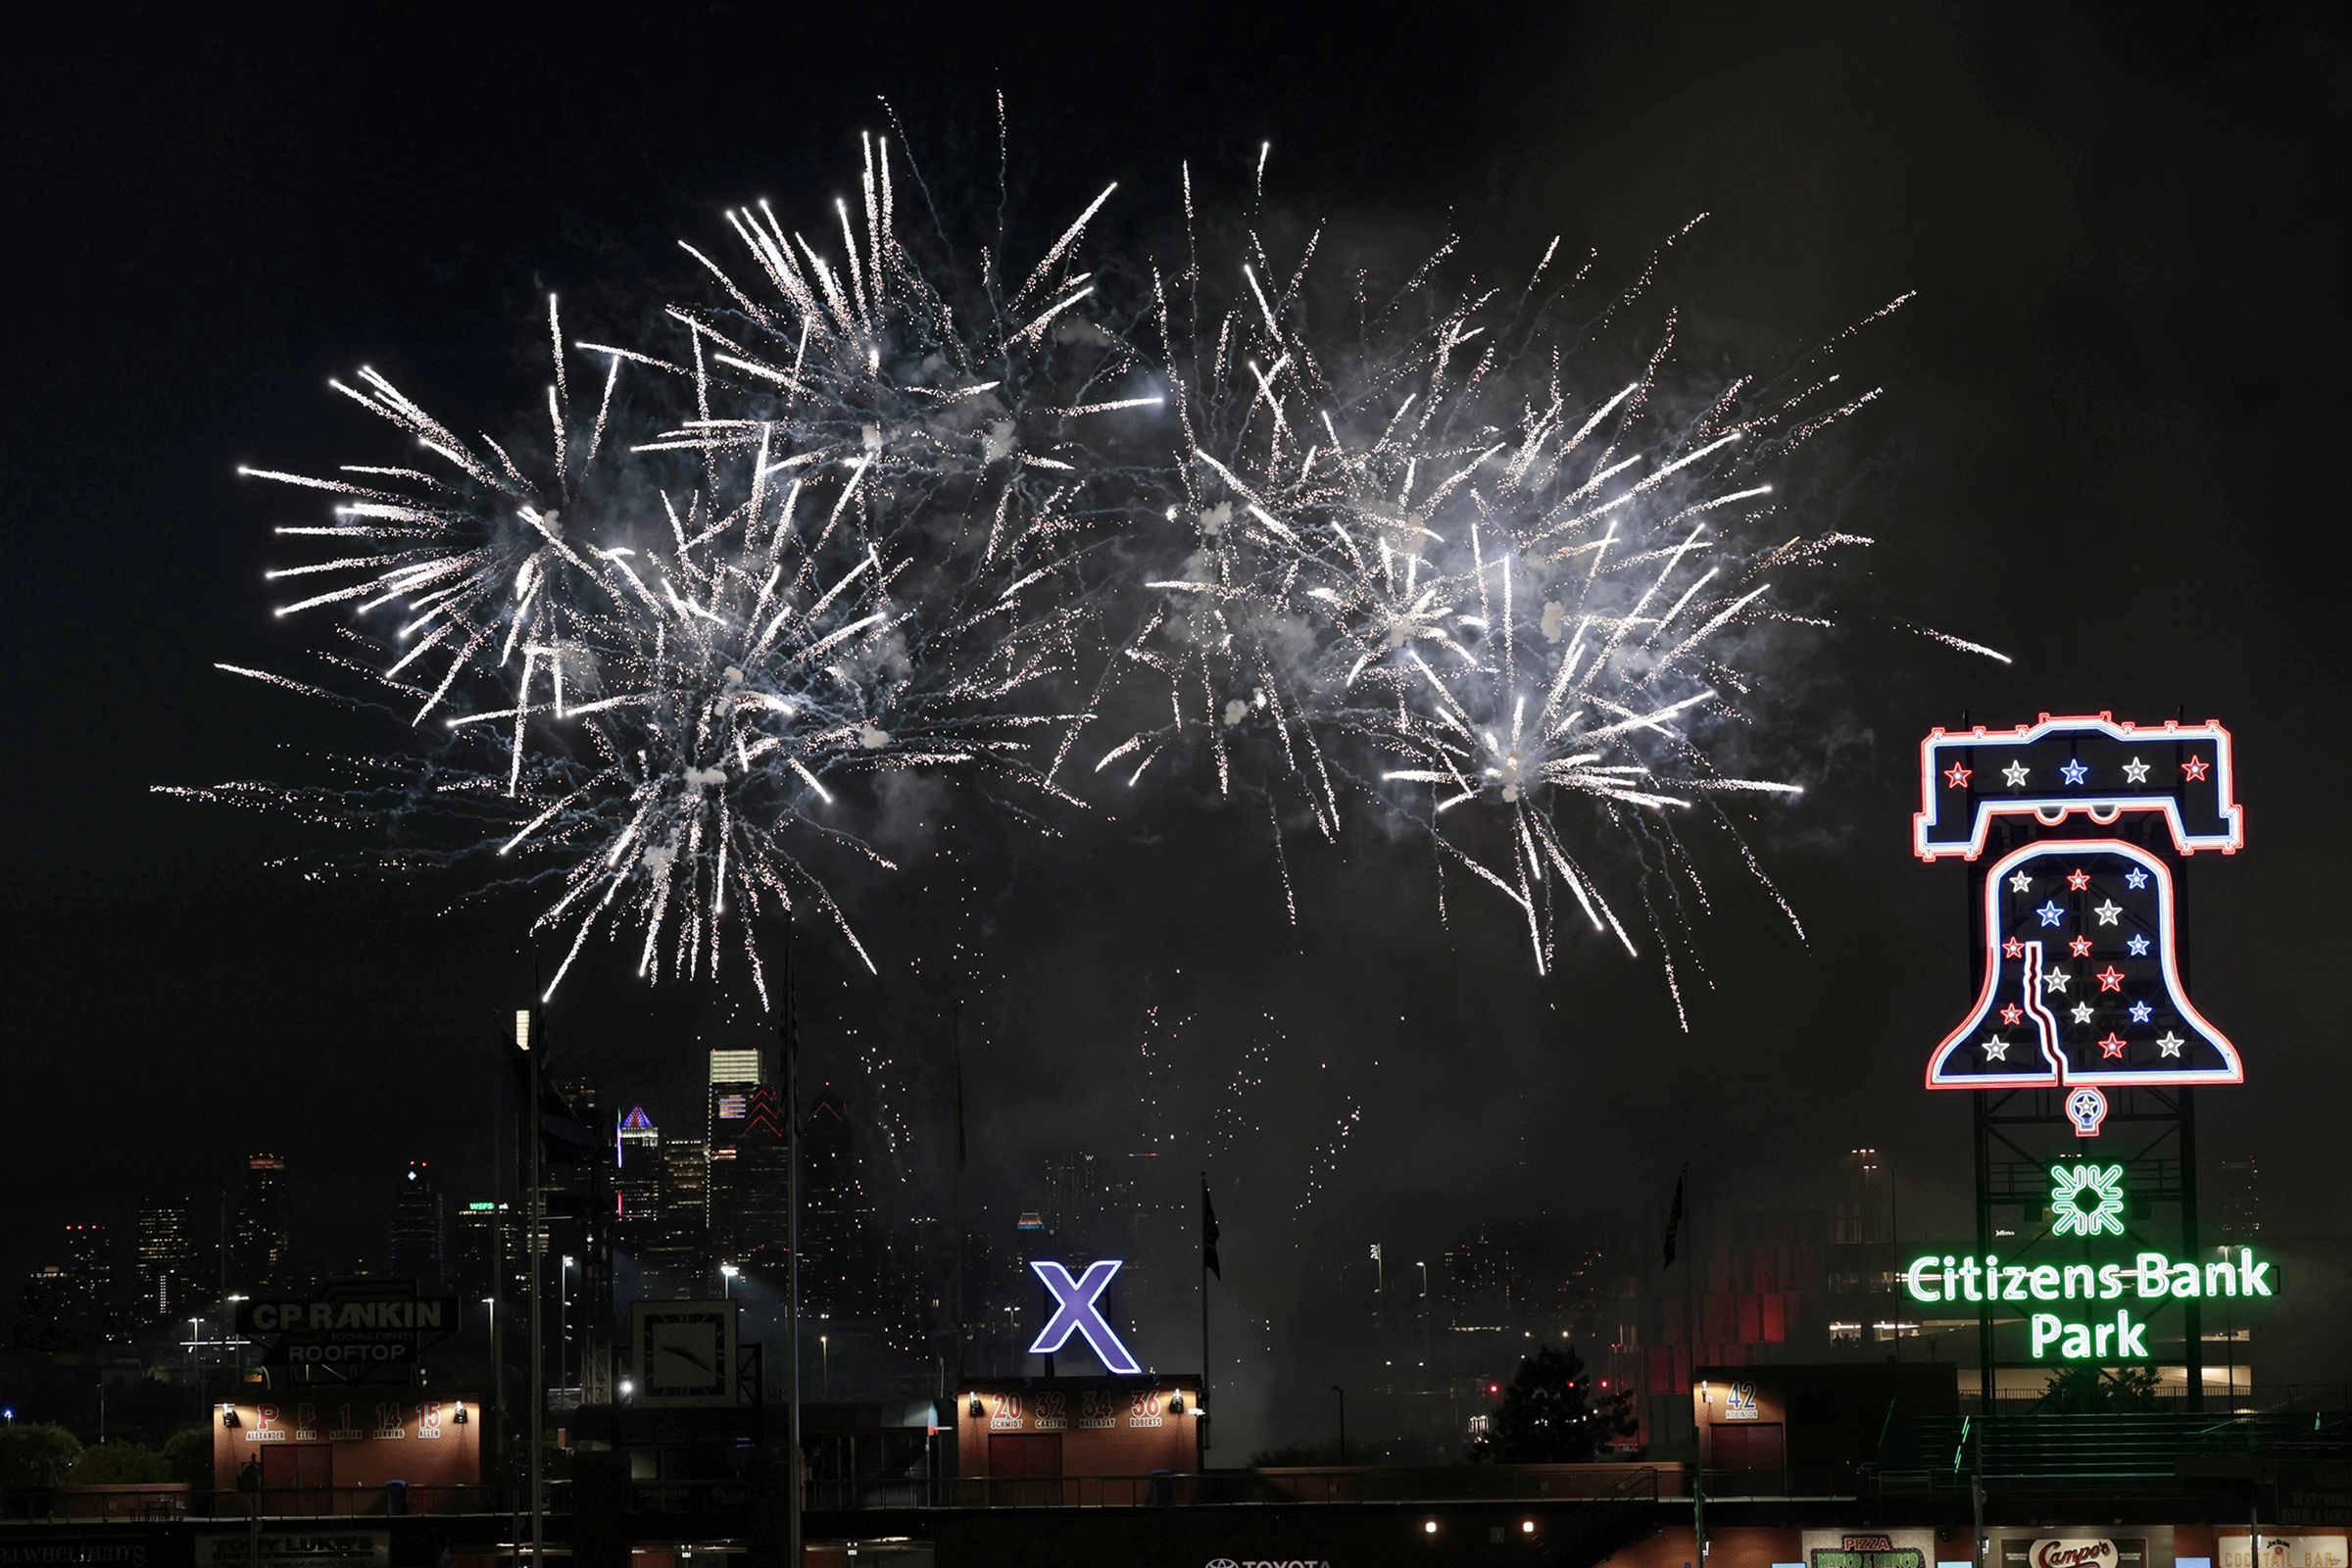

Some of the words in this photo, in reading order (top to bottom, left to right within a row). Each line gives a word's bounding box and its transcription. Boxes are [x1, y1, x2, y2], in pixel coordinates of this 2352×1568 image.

[1907, 1255, 2125, 1301] Citizens
[2136, 1248, 2273, 1298] Bank
[253, 1304, 302, 1330] CP
[310, 1300, 441, 1329] RANKIN
[1028, 1259, 1142, 1374] X
[332, 1333, 372, 1342] ROOFING
[375, 1332, 415, 1341] EXPERTS
[2032, 1308, 2148, 1358] Park
[289, 1344, 406, 1363] ROOFTOP
[992, 1393, 1022, 1419] 20
[1036, 1392, 1065, 1419] 32
[1082, 1391, 1112, 1418] 34
[1131, 1391, 1160, 1418] 36
[1727, 1382, 1756, 1409] 42
[256, 1403, 279, 1430] P
[339, 1402, 350, 1430] 1
[375, 1402, 401, 1430] 14
[416, 1401, 440, 1429] 15
[992, 1419, 1022, 1429] SCHMIDT
[1035, 1419, 1067, 1429] CARLTON
[1080, 1418, 1115, 1428] HALLADAY
[1130, 1418, 1161, 1428] ROBERTS
[1726, 1410, 1757, 1419] ROBINSON
[246, 1431, 285, 1440] ALEXANDER
[418, 1428, 440, 1438] ALLEN
[1843, 1537, 1890, 1551] PIZZA
[2038, 1540, 2112, 1568] Campo's
[1817, 1553, 1862, 1568] MANCO
[1863, 1554, 1873, 1568] &
[1874, 1553, 1920, 1568] MANCO
[2304, 1552, 2332, 1567] BAR
